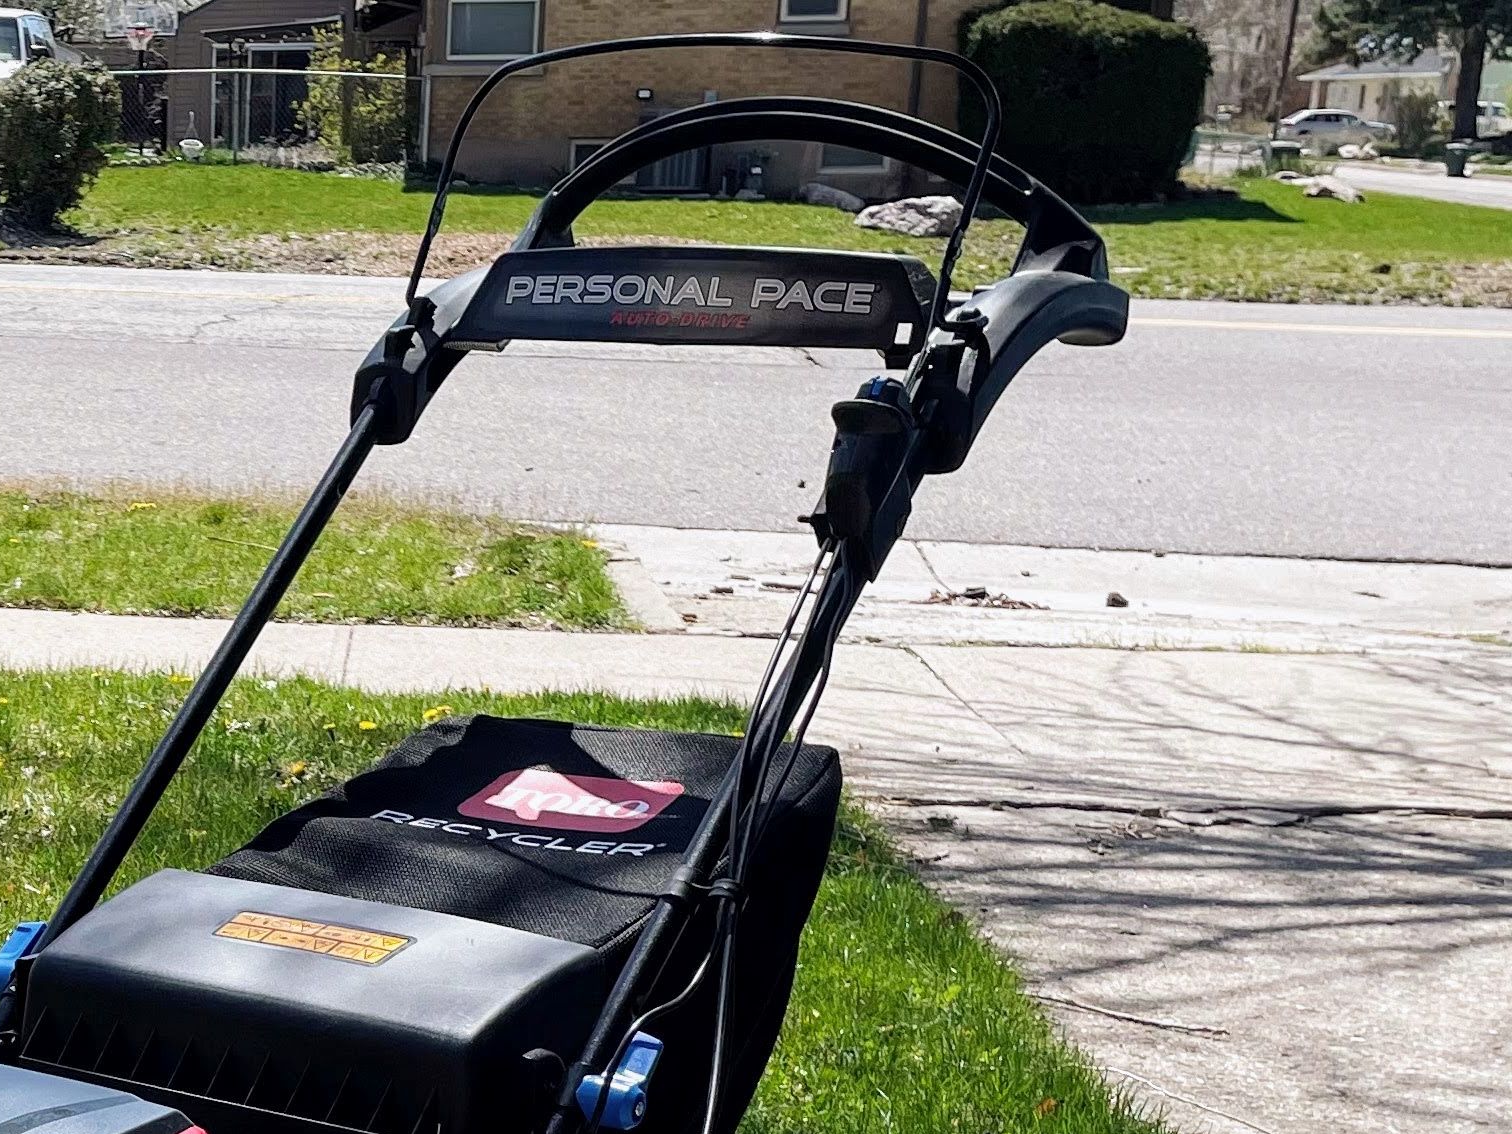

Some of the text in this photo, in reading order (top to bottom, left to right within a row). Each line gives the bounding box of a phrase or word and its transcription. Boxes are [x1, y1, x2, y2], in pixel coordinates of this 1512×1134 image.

[505, 275, 876, 314] PERSONAL PACE
[609, 310, 751, 329] AUTO-DRIVE
[370, 809, 655, 856] RECYCLER
